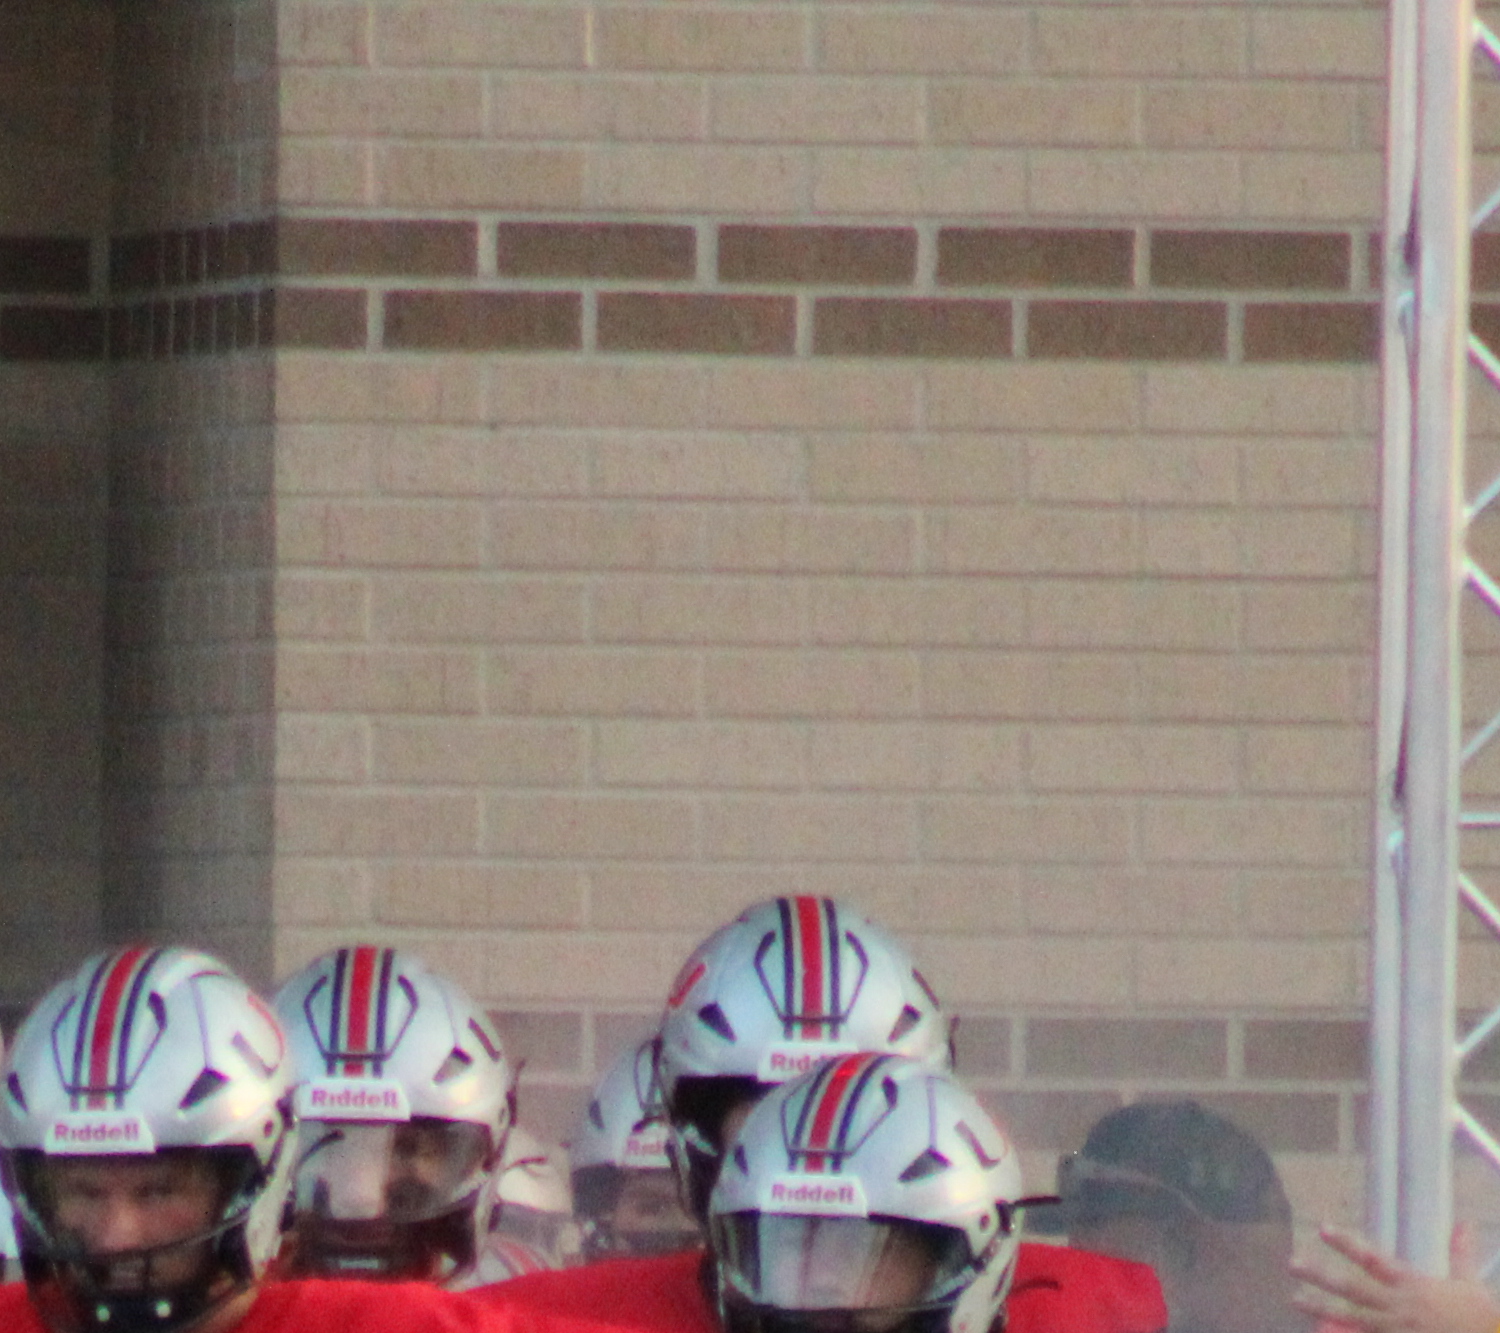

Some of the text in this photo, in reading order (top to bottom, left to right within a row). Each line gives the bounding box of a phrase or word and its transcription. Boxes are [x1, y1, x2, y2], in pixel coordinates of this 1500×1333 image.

[311, 1088, 398, 1109] Riddell
[53, 1121, 139, 1141] Riddell
[771, 1182, 855, 1204] Riddell
